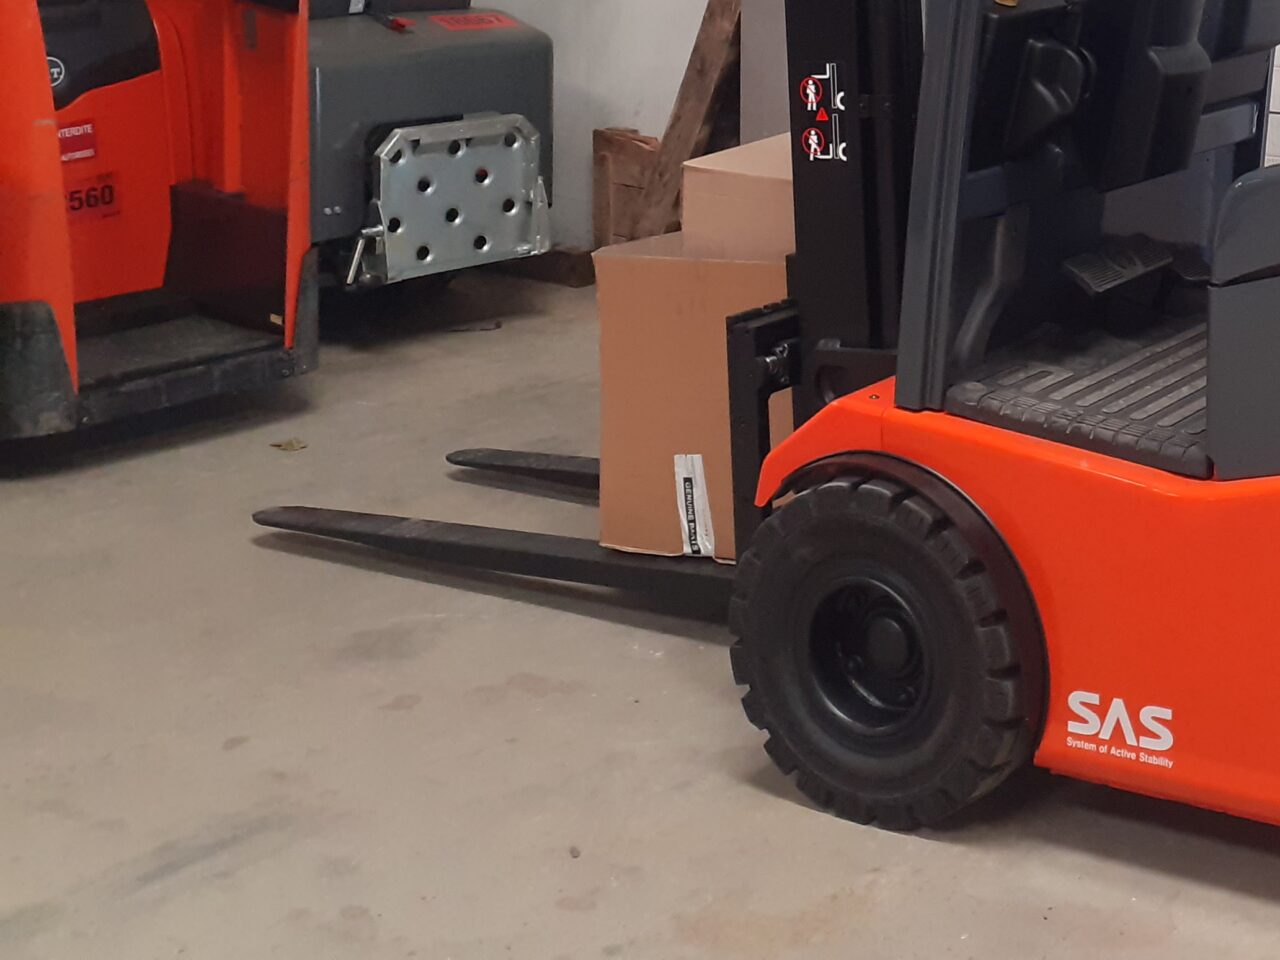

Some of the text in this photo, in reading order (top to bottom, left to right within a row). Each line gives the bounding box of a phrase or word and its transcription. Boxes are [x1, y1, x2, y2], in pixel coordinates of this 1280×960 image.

[65, 184, 115, 211] 560
[1067, 690, 1174, 751] SAS
[1066, 736, 1174, 769] System of Active Stability
